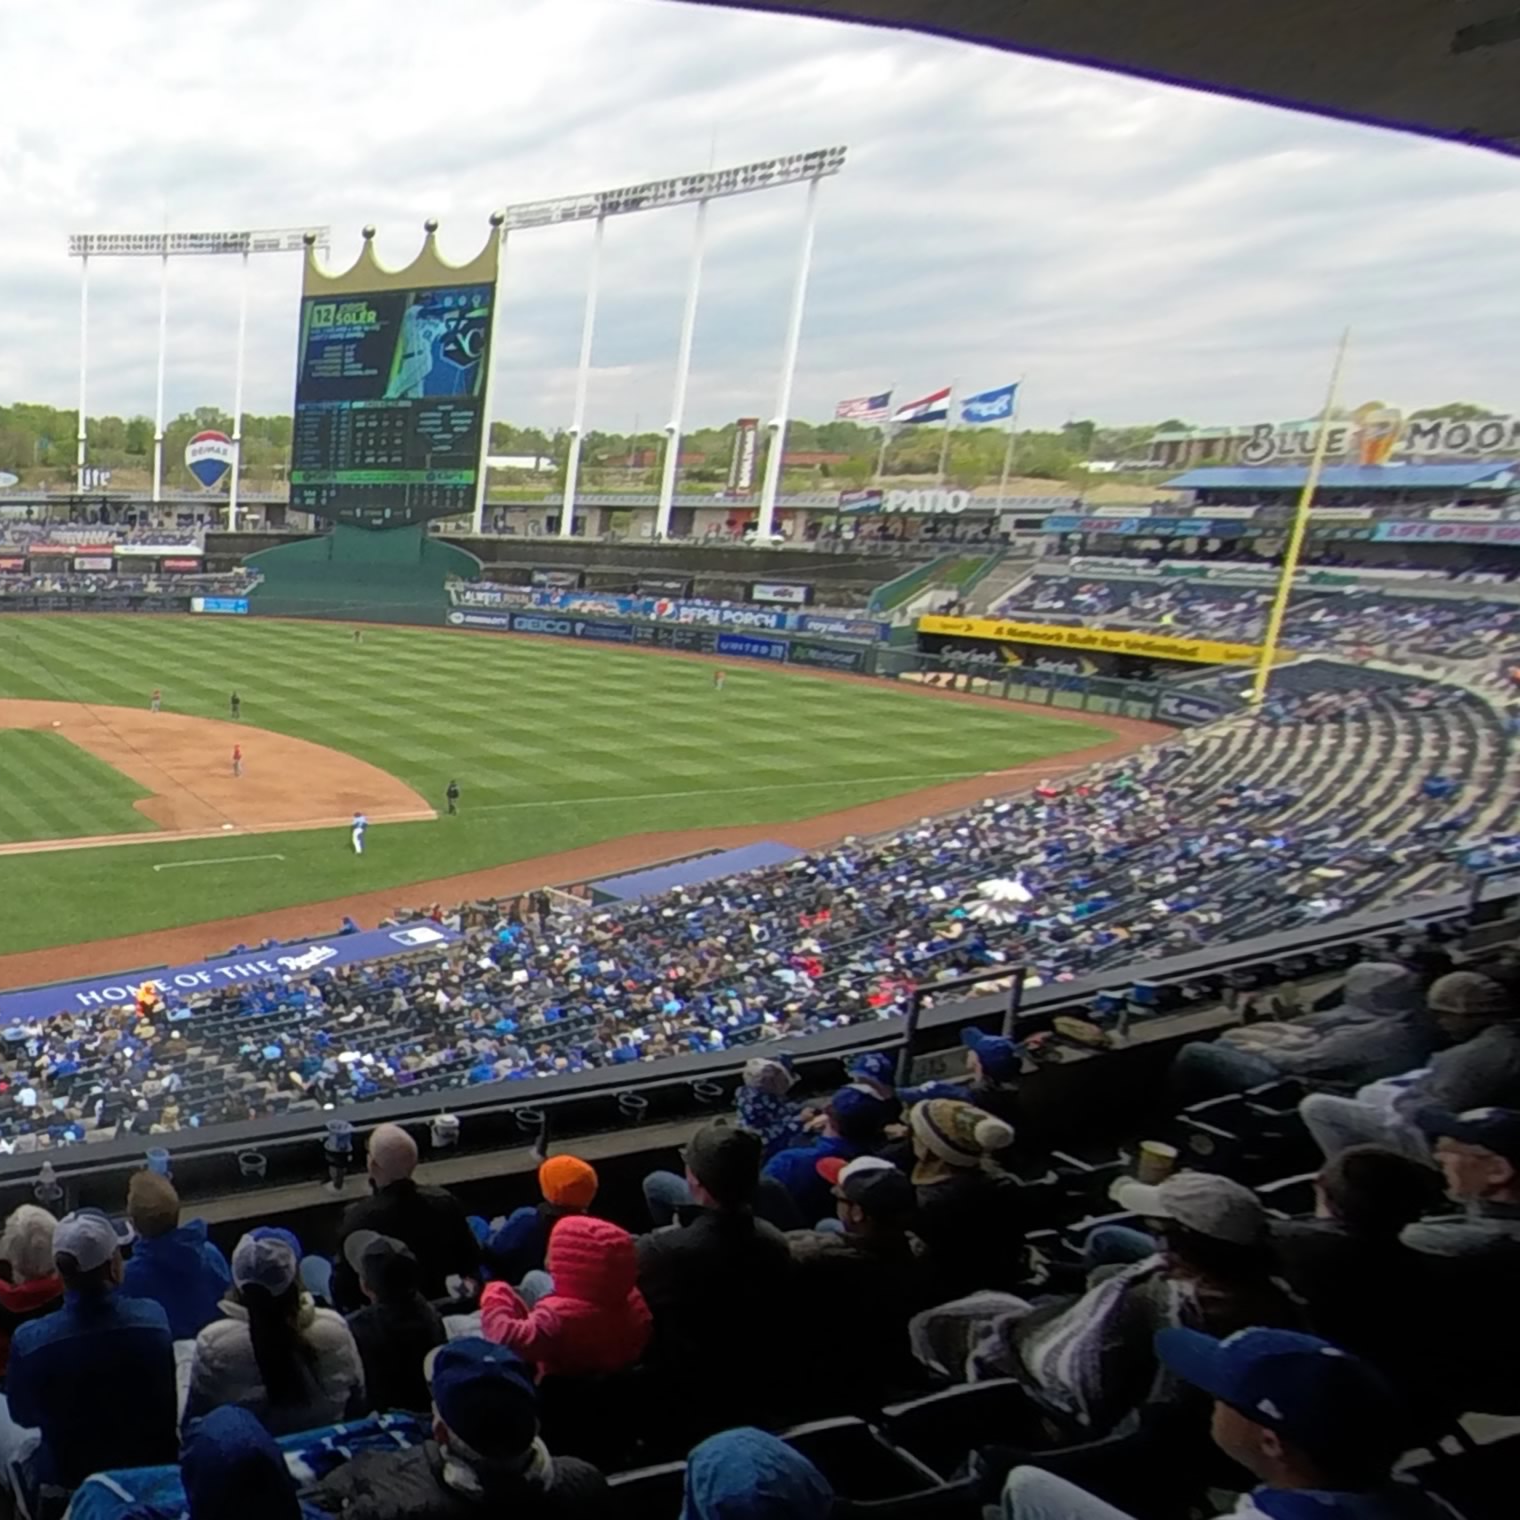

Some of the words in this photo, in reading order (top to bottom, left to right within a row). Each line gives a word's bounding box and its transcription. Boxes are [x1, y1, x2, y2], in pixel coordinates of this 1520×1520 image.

[316, 308, 332, 323] 12
[336, 311, 377, 324] SOLER
[1406, 421, 1520, 451] MOO
[887, 490, 970, 514] PATIO
[514, 616, 571, 634] GEICO
[679, 606, 720, 623] PEPSI
[722, 609, 777, 628] PORCH
[720, 641, 770, 655] UNITED
[174, 971, 213, 988] OF
[217, 959, 279, 984] THE
[277, 944, 338, 971] Royals
